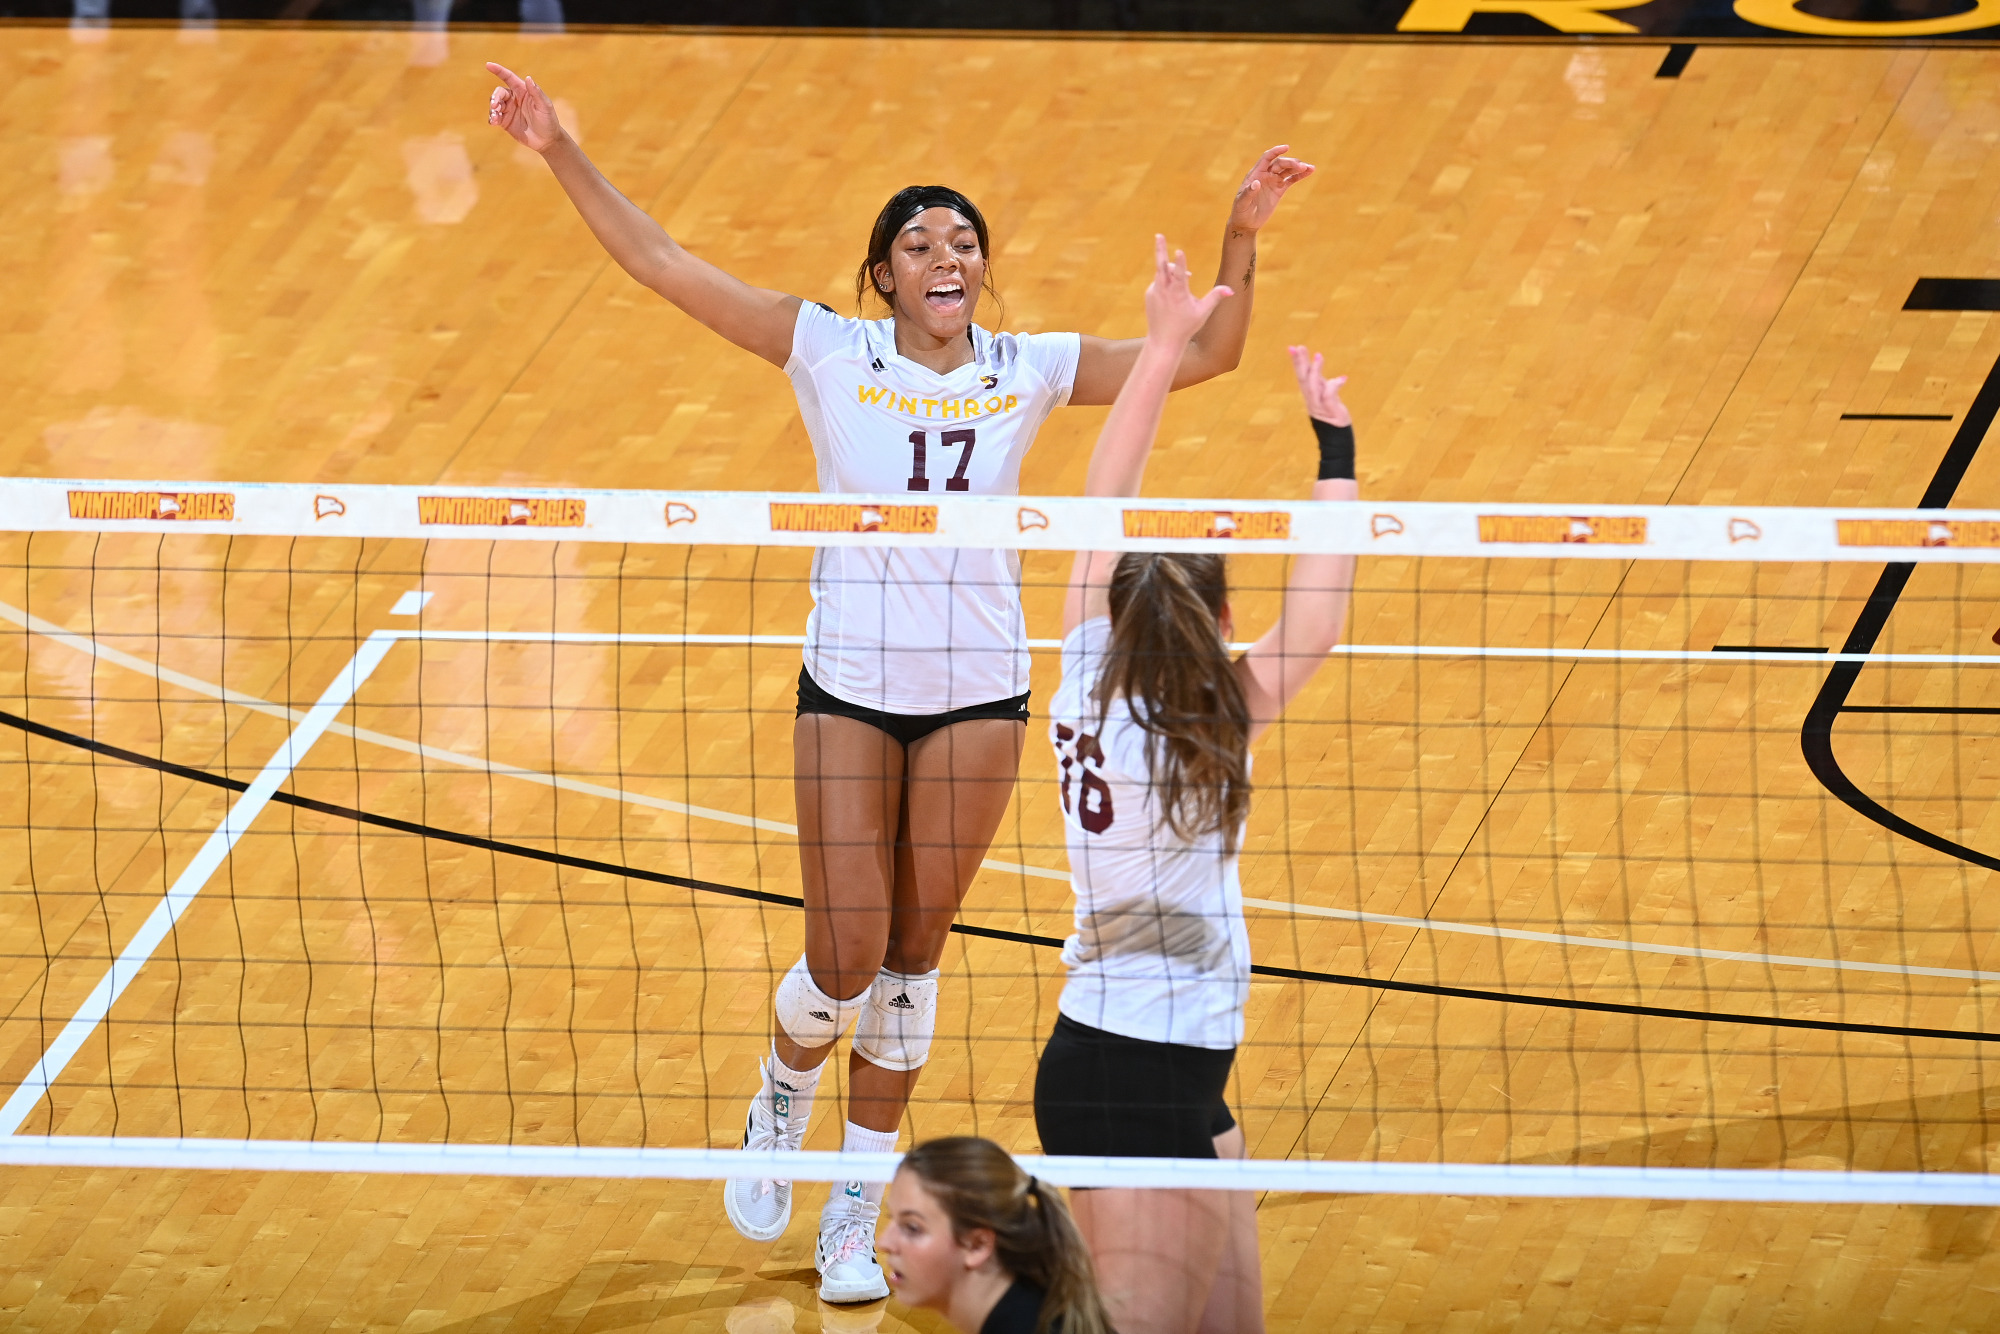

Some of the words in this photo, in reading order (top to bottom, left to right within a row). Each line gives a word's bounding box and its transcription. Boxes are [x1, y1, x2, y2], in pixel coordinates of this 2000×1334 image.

[858, 384, 1018, 419] WINTHROP
[907, 428, 976, 492] 17
[67, 491, 160, 519] WINTHROP
[175, 492, 235, 521] EAGLES
[418, 496, 511, 526] WINTHROP
[526, 498, 586, 527] EAGLES
[769, 503, 862, 533] WINTHROP
[878, 505, 938, 533] EAGLES
[1122, 510, 1215, 538] WINTHROP
[888, 1000, 915, 1010] adidas
